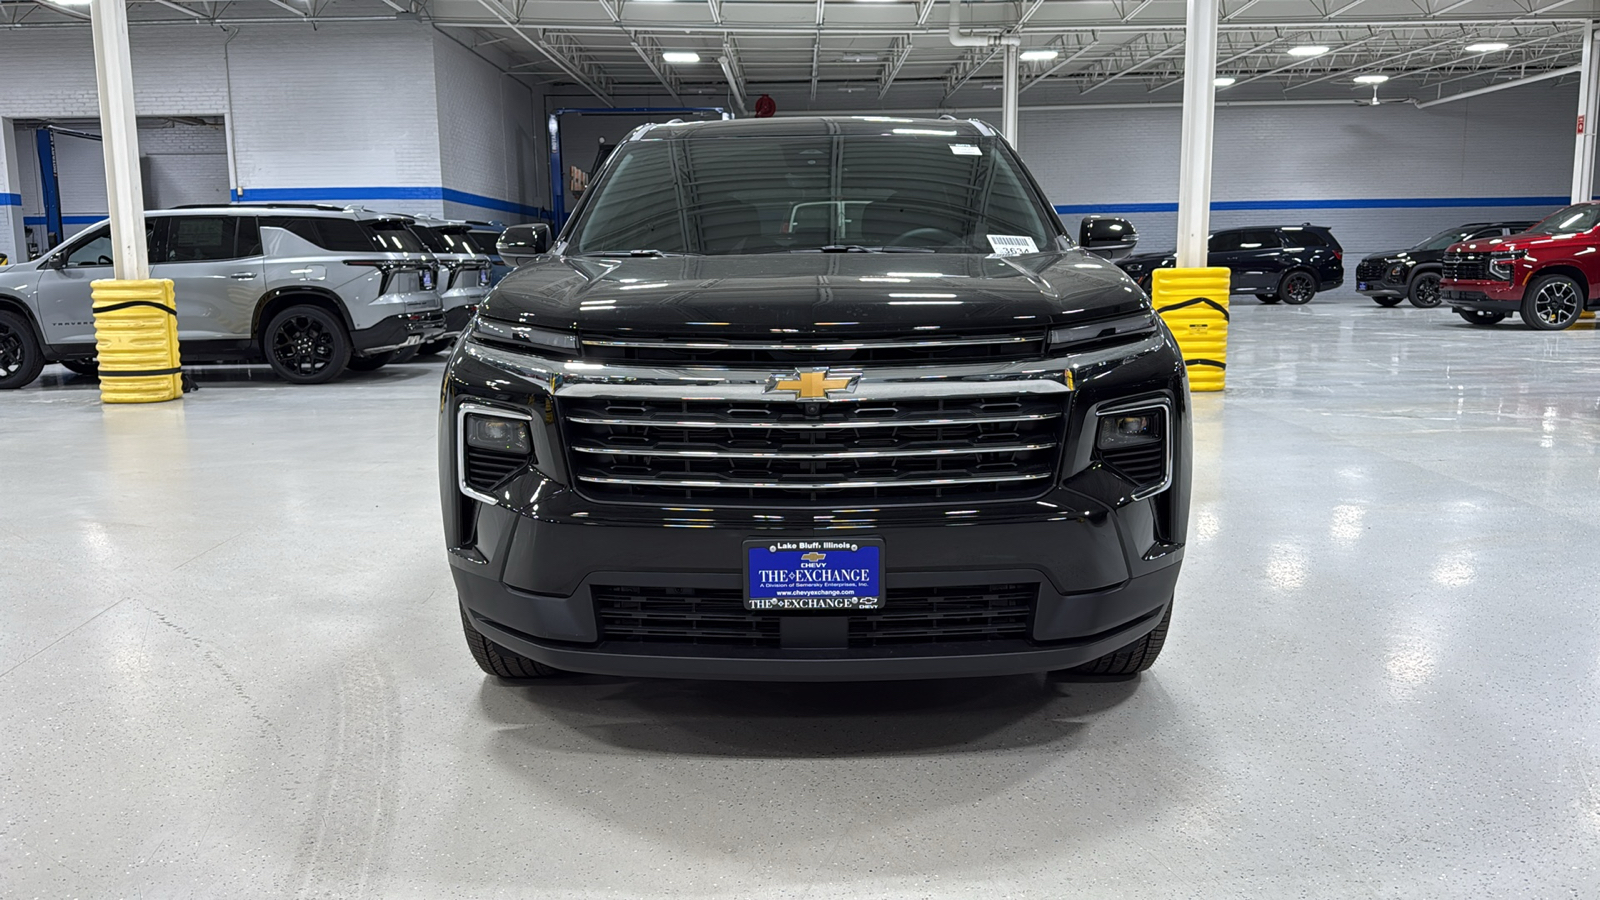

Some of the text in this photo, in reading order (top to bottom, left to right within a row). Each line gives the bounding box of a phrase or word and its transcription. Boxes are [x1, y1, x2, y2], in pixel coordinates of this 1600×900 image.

[823, 541, 850, 549] Illinois
[758, 569, 870, 582] THE EXCHANGE
[748, 598, 852, 609] THE EXCHANGE
